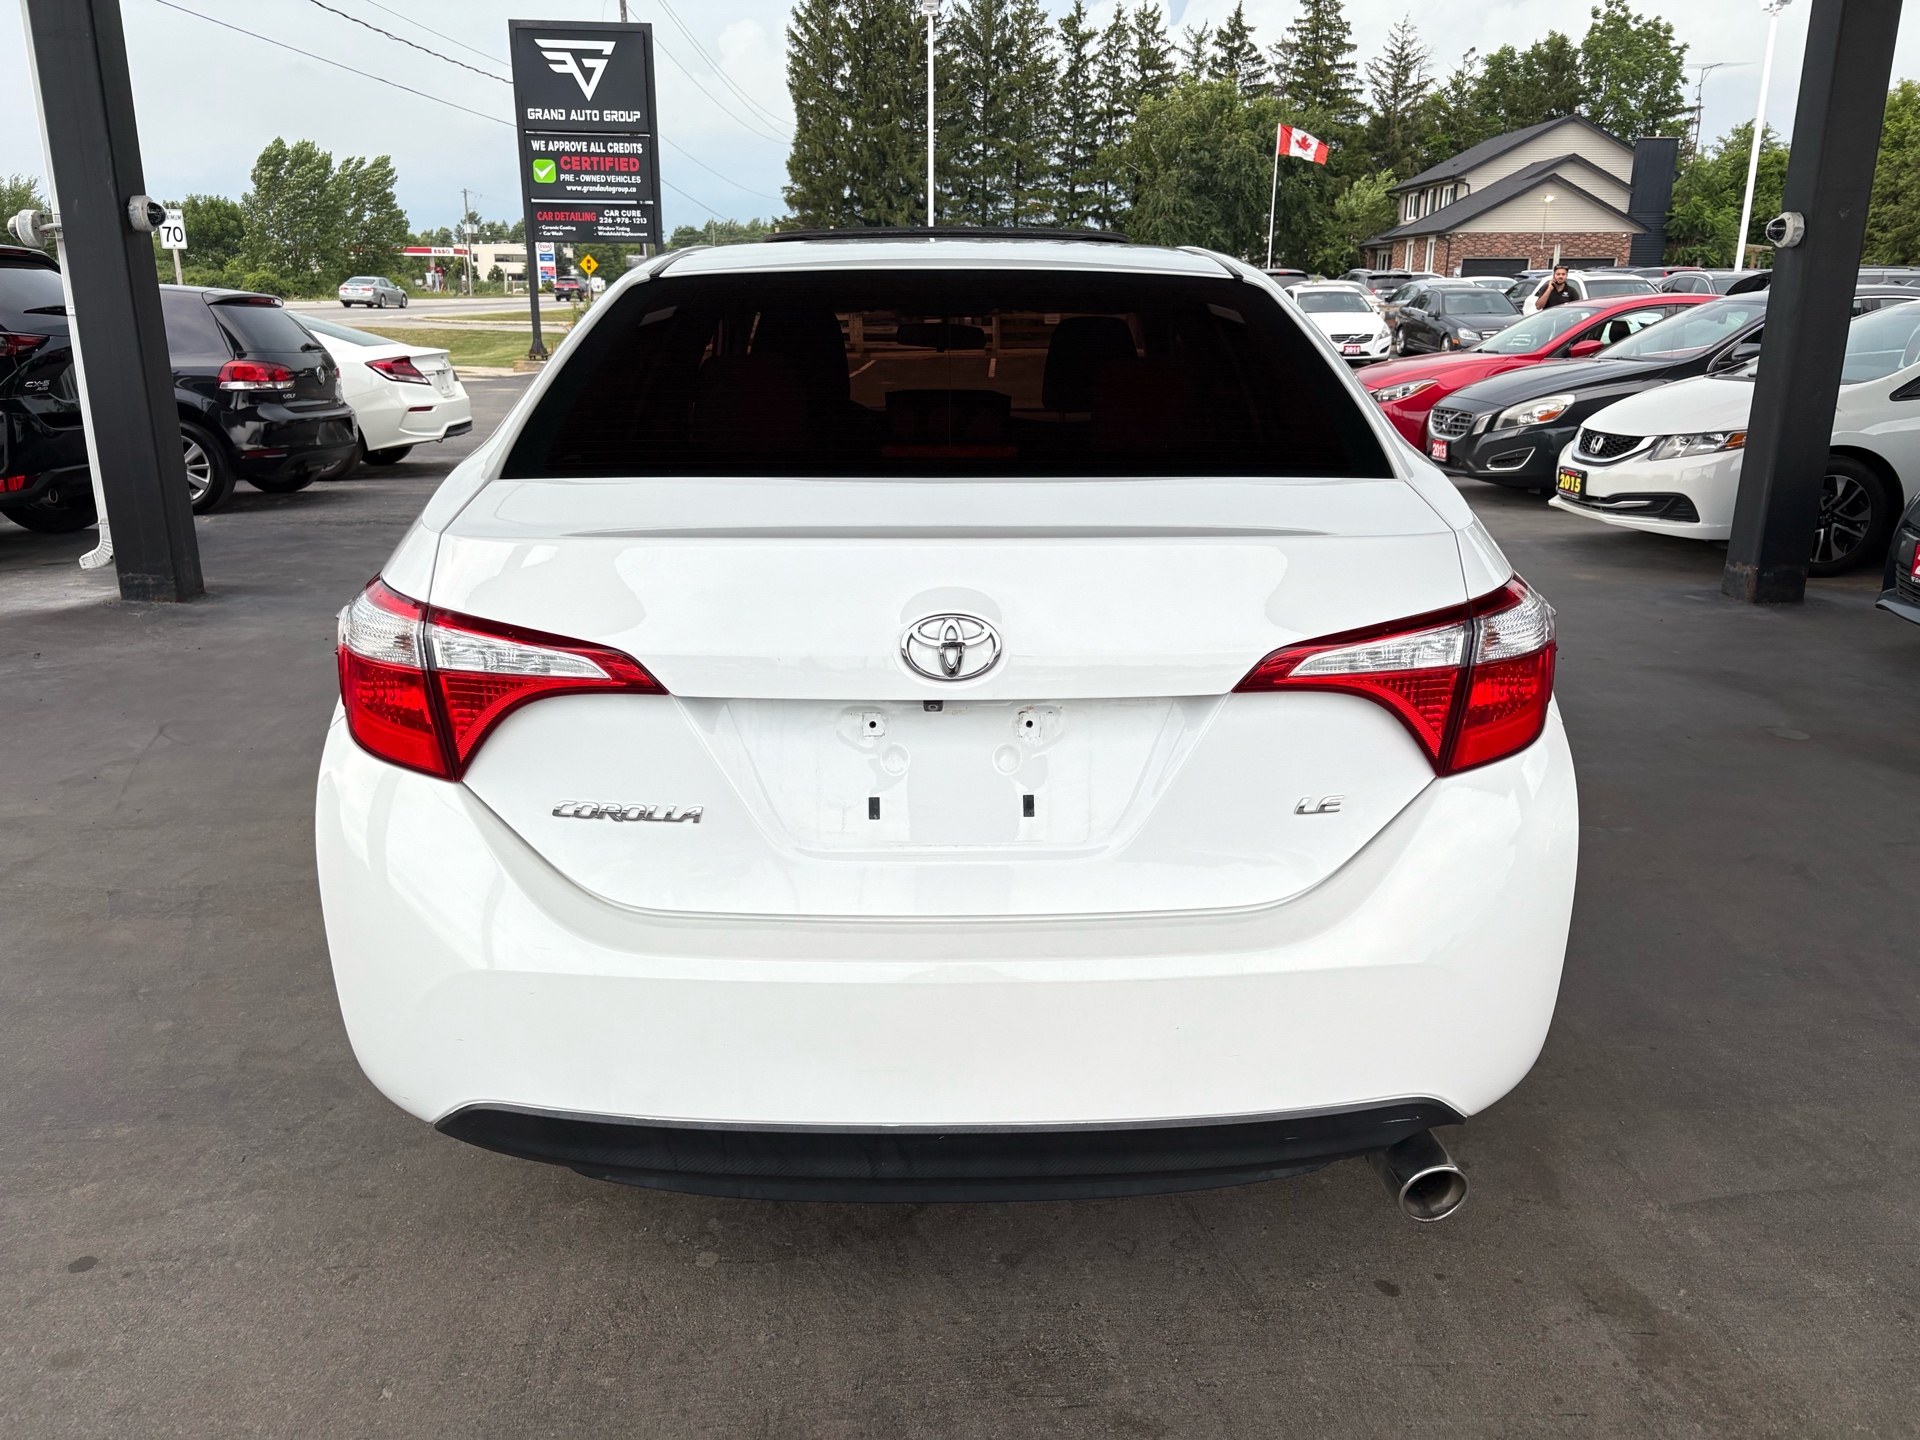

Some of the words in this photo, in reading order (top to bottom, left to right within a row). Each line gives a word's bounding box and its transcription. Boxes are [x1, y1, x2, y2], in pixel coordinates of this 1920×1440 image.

[527, 108, 566, 120] GRAND
[570, 109, 600, 121] AUTO
[603, 110, 641, 122] GROUP
[531, 140, 545, 151] WE
[548, 141, 587, 152] APPROVE
[590, 142, 605, 153] ALL
[607, 142, 643, 154] CREDITS
[560, 156, 640, 172] CERTIFIED
[606, 175, 642, 184] VEHICLES
[565, 184, 637, 194] www.grandautogroup.ca
[537, 211, 553, 221] CAR
[554, 211, 597, 222] DETAILING
[604, 209, 620, 217] CAR
[162, 226, 183, 242] 70
[1344, 346, 1360, 354] 2011
[25, 379, 50, 387] CX-5
[1432, 443, 1446, 458] 2013
[1559, 473, 1581, 493] 2015
[552, 800, 704, 824] COROLLA
[1294, 795, 1345, 815] LE
